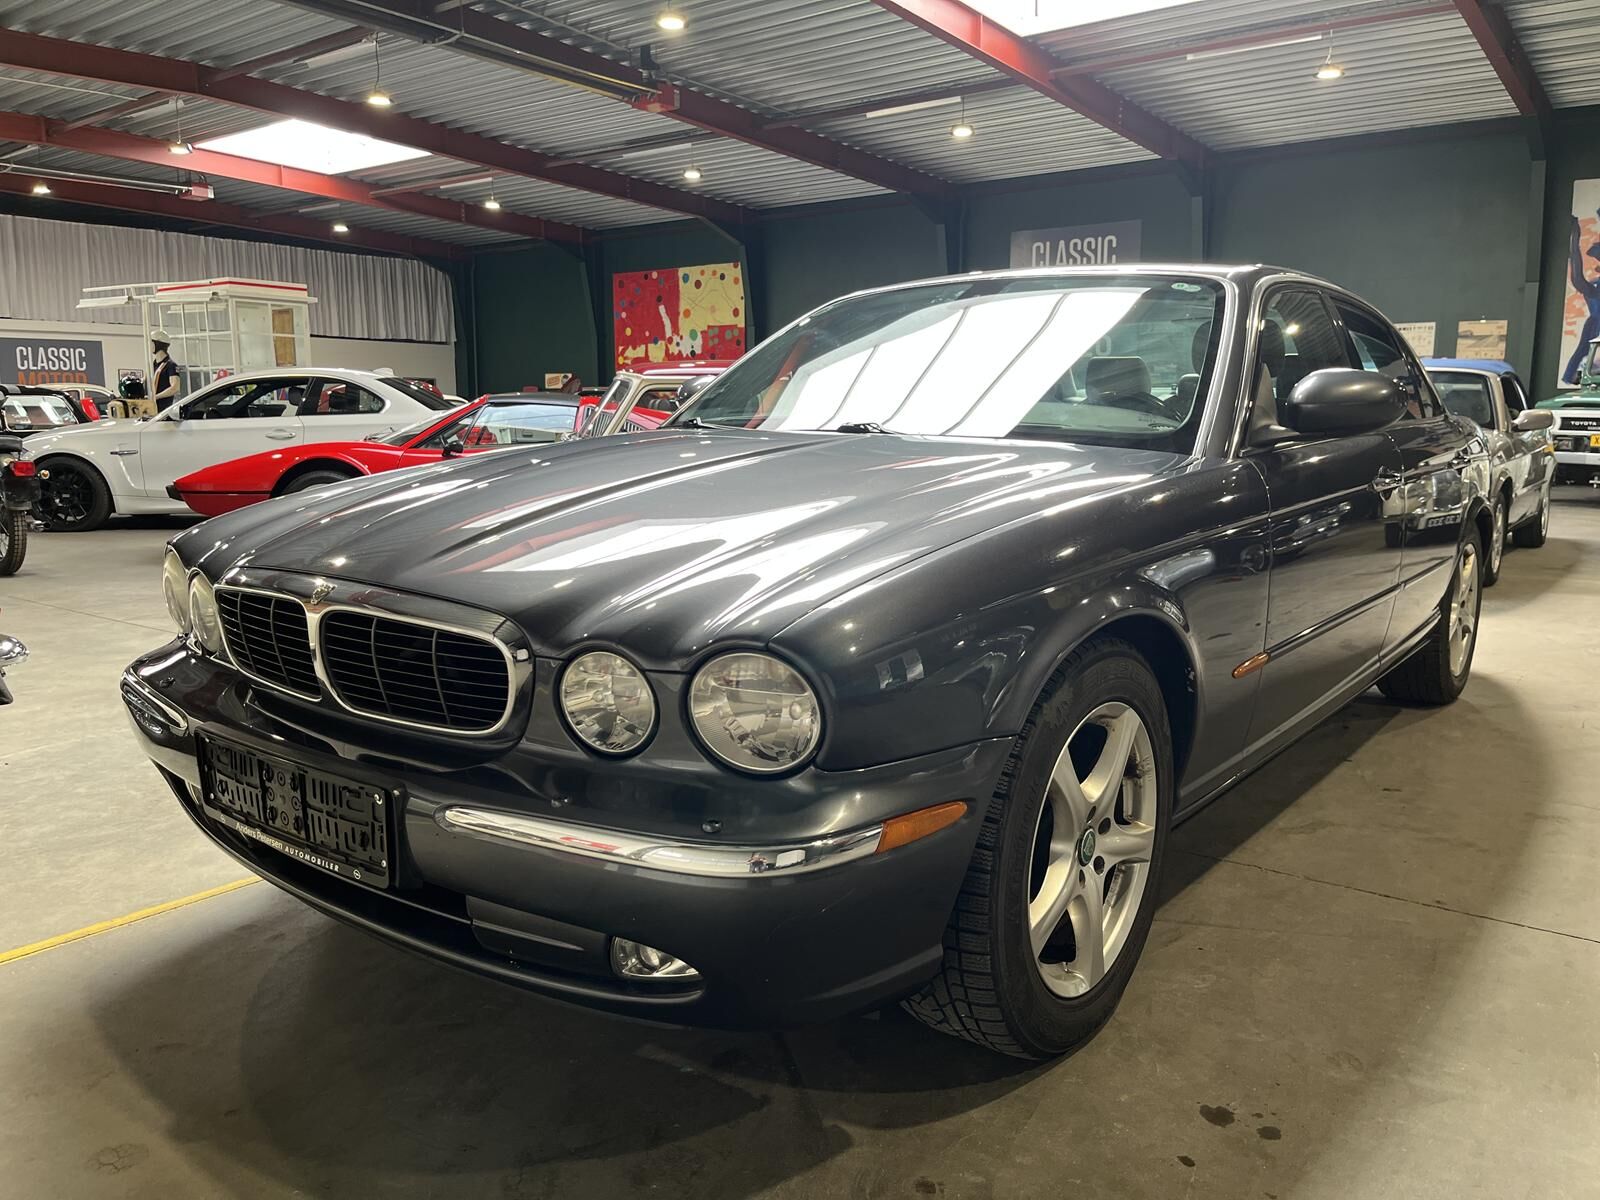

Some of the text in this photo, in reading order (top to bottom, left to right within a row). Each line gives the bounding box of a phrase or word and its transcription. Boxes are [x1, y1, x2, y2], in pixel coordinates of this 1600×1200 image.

[1031, 235, 1117, 267] CLASSIC
[16, 346, 87, 371] CLASSIC
[236, 822, 339, 872] Anders Petersen AUTOMOBILER
